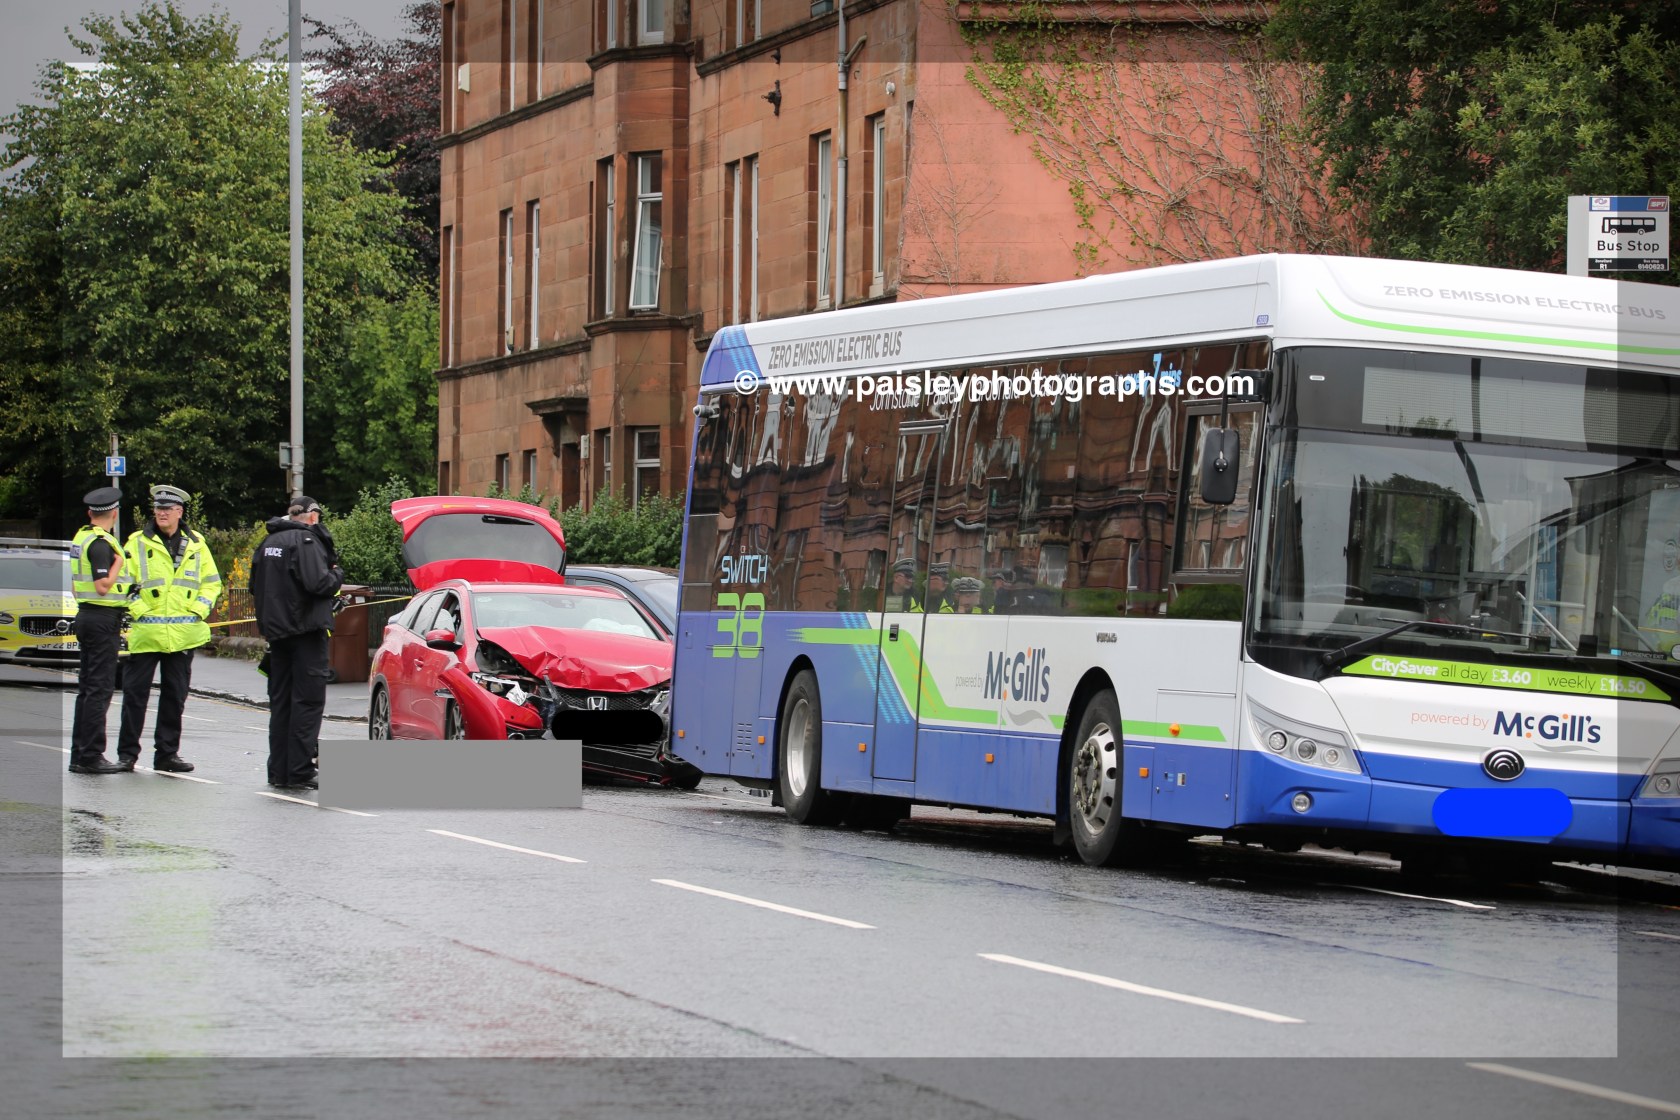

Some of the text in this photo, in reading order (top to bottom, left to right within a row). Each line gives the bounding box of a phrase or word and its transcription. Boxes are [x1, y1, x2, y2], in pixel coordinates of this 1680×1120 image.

[1597, 240, 1659, 253] Bus Stop
[1383, 285, 1666, 320] ZERO EMISSION ELECTRIC BUS
[768, 330, 903, 370] ZERO EMISSION ELECTRIC BUS
[720, 554, 768, 584] SWITCH
[712, 592, 765, 659] 38
[1622, 650, 1652, 659] EMERGENCY
[984, 646, 1050, 703] McGill's
[1371, 657, 1646, 695] CitySaver all day £3.60 weekly £16.50
[1411, 710, 1601, 744] powered by McGill's
